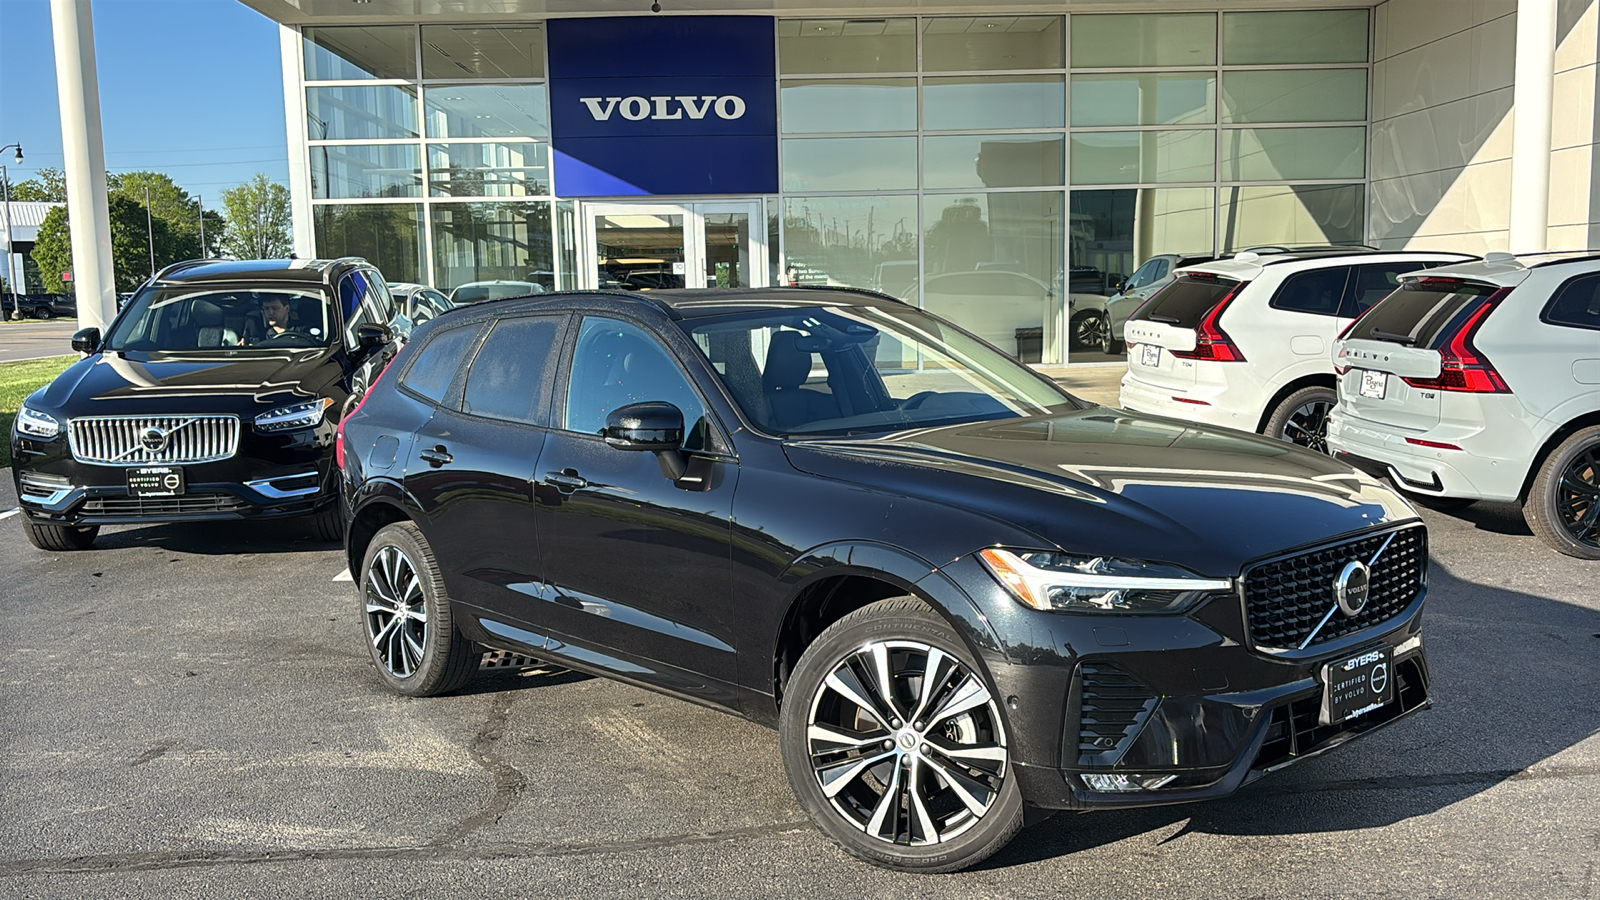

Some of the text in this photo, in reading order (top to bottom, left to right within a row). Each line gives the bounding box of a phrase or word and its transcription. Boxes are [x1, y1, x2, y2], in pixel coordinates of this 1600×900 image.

[579, 95, 746, 121] VOLVO
[1132, 329, 1161, 338] VOLVO
[1346, 350, 1389, 362] VOLVO
[865, 623, 953, 642] CONTINENTAL
[1347, 650, 1379, 670] BYERS
[1334, 674, 1366, 693] CERTIFIED
[1334, 686, 1365, 704] BY VOLVO
